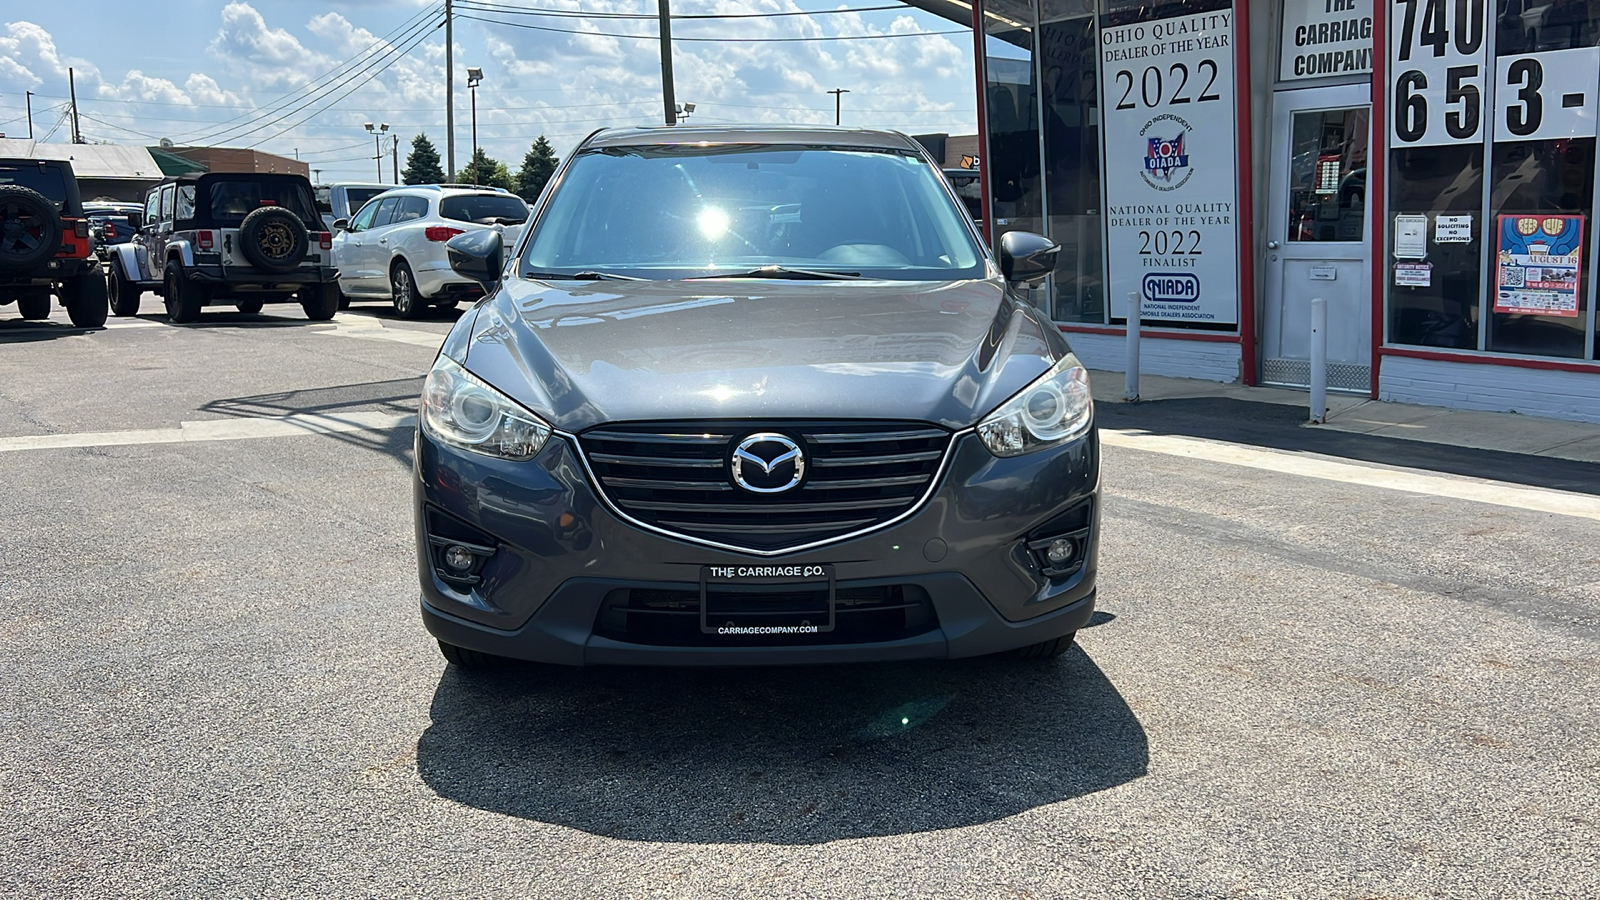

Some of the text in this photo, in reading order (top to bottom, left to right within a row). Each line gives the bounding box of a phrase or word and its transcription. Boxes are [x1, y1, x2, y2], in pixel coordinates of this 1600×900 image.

[1325, 0, 1355, 13] THE
[1103, 13, 1231, 45] OHIO QUALITY
[1295, 17, 1373, 47] CARRIAG
[1395, 0, 1483, 61] 740
[1105, 45, 1148, 62] DEALER
[1151, 43, 1167, 56] OF
[1169, 39, 1193, 54] THE
[1196, 34, 1229, 50] YEAR
[1115, 59, 1220, 110] 2022
[1139, 113, 1194, 137] OHIO INDEPENDENT
[1149, 156, 1181, 169] OIADA
[1109, 202, 1232, 215] NATIONAL QUALITY
[1111, 216, 1231, 227] DEALER OF THE YEAR
[1138, 230, 1202, 255] 2022
[1143, 258, 1197, 267] FINALIST
[1527, 255, 1577, 264] AUGUST 16
[1147, 279, 1194, 296] NIADA
[1181, 312, 1214, 320] ASSOCIATION
[710, 565, 825, 577] THE CARRIAGE CO.
[718, 626, 818, 635] CARRIAGECOMPANY.COM
